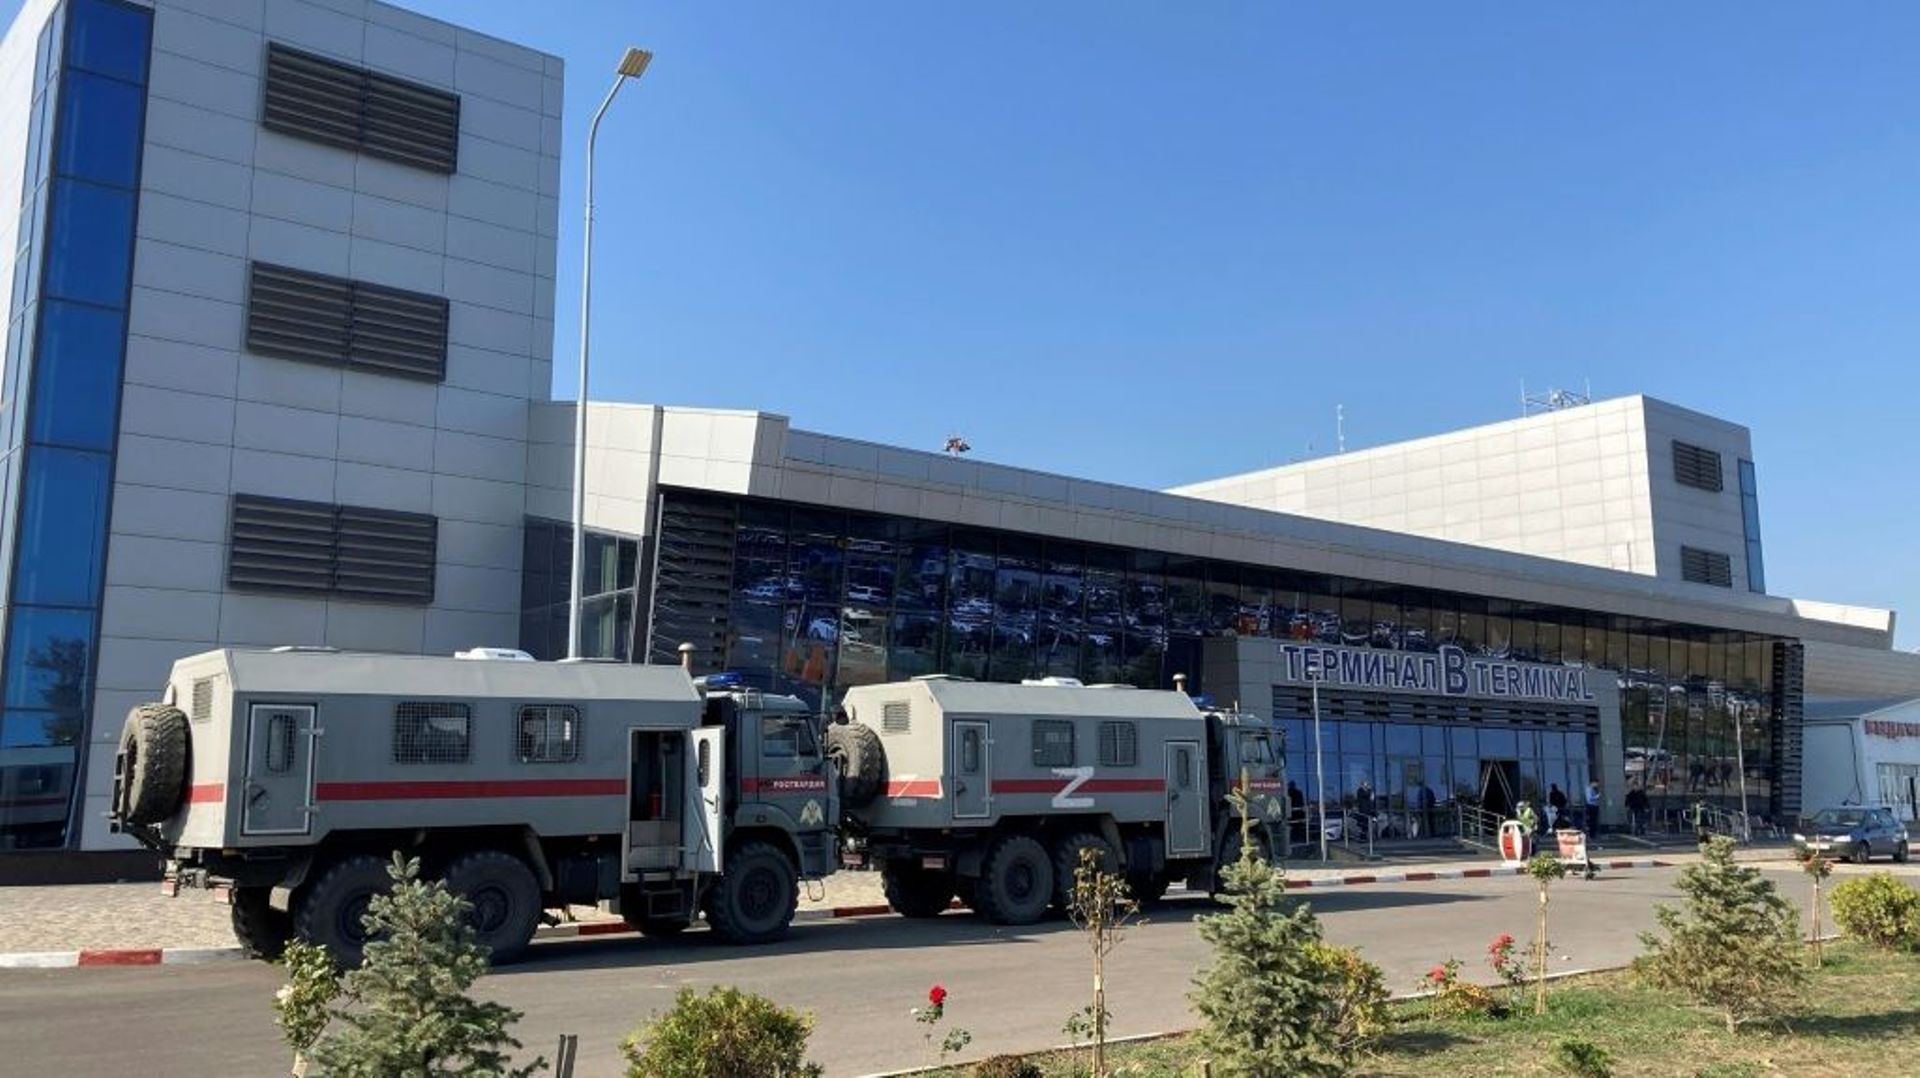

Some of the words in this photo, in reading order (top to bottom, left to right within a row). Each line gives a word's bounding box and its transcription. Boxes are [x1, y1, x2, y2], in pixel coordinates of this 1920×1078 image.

[1280, 644, 1439, 691] ТЕРМИНАЛ
[1472, 661, 1595, 701] TERMINAL
[1051, 766, 1095, 808] Z
